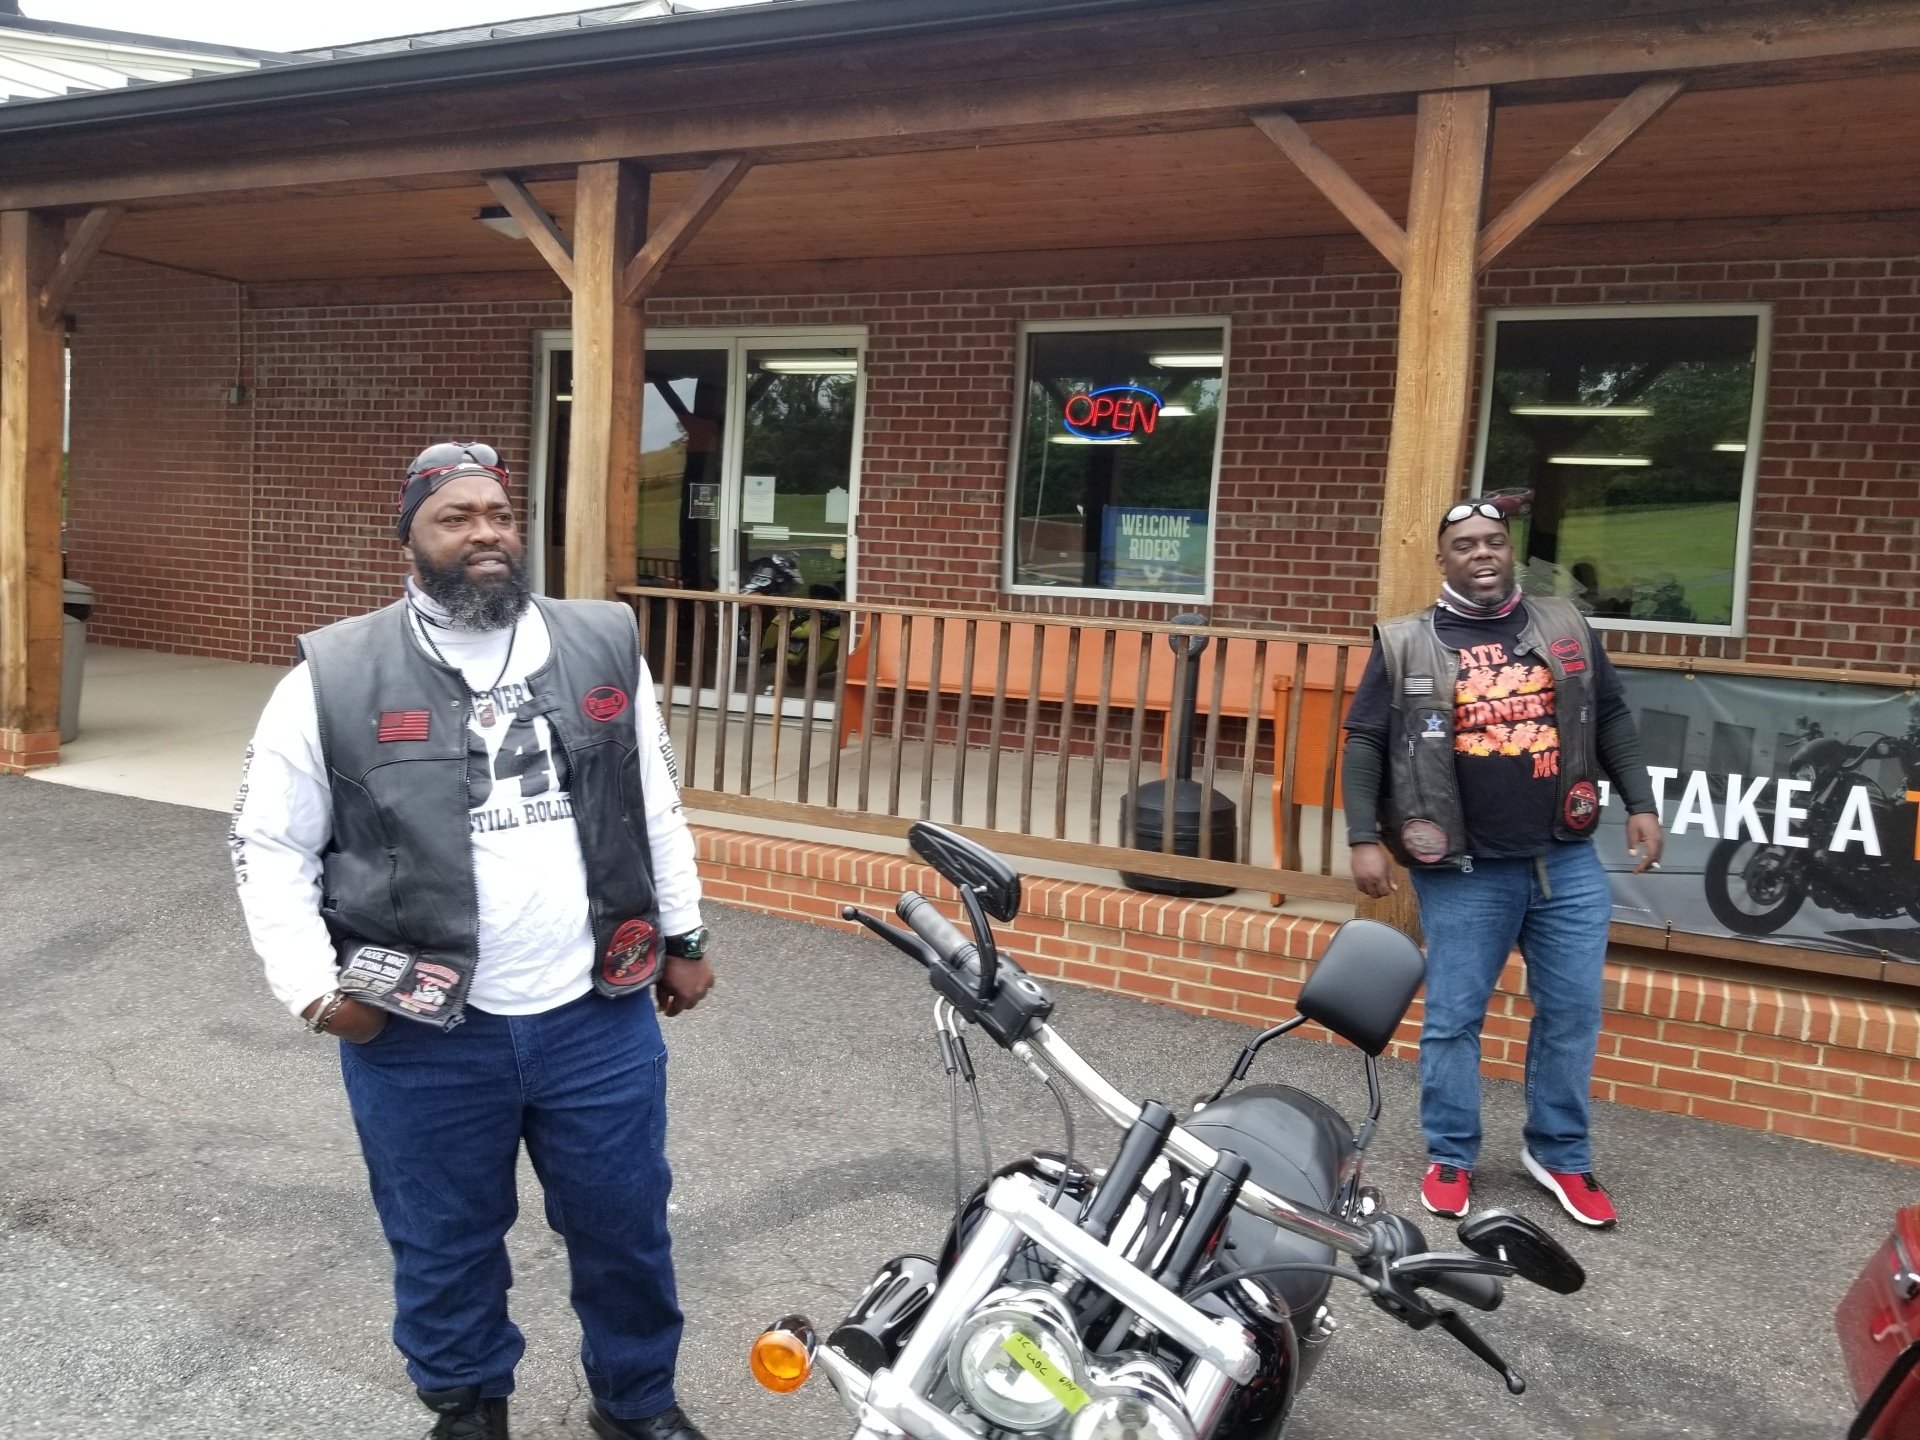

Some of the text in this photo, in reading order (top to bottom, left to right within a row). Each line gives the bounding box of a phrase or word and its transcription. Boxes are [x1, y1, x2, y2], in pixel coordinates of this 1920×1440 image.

[1064, 394, 1159, 434] OPEN
[1121, 513, 1191, 539] WELCOME
[1128, 537, 1181, 562] RIDERS
[1459, 643, 1508, 670] ATE
[470, 808, 520, 834] TILL
[1646, 766, 1812, 849] TAKE
[1828, 785, 1882, 857] A
[362, 950, 386, 961] RODE
[384, 954, 407, 967] MINE
